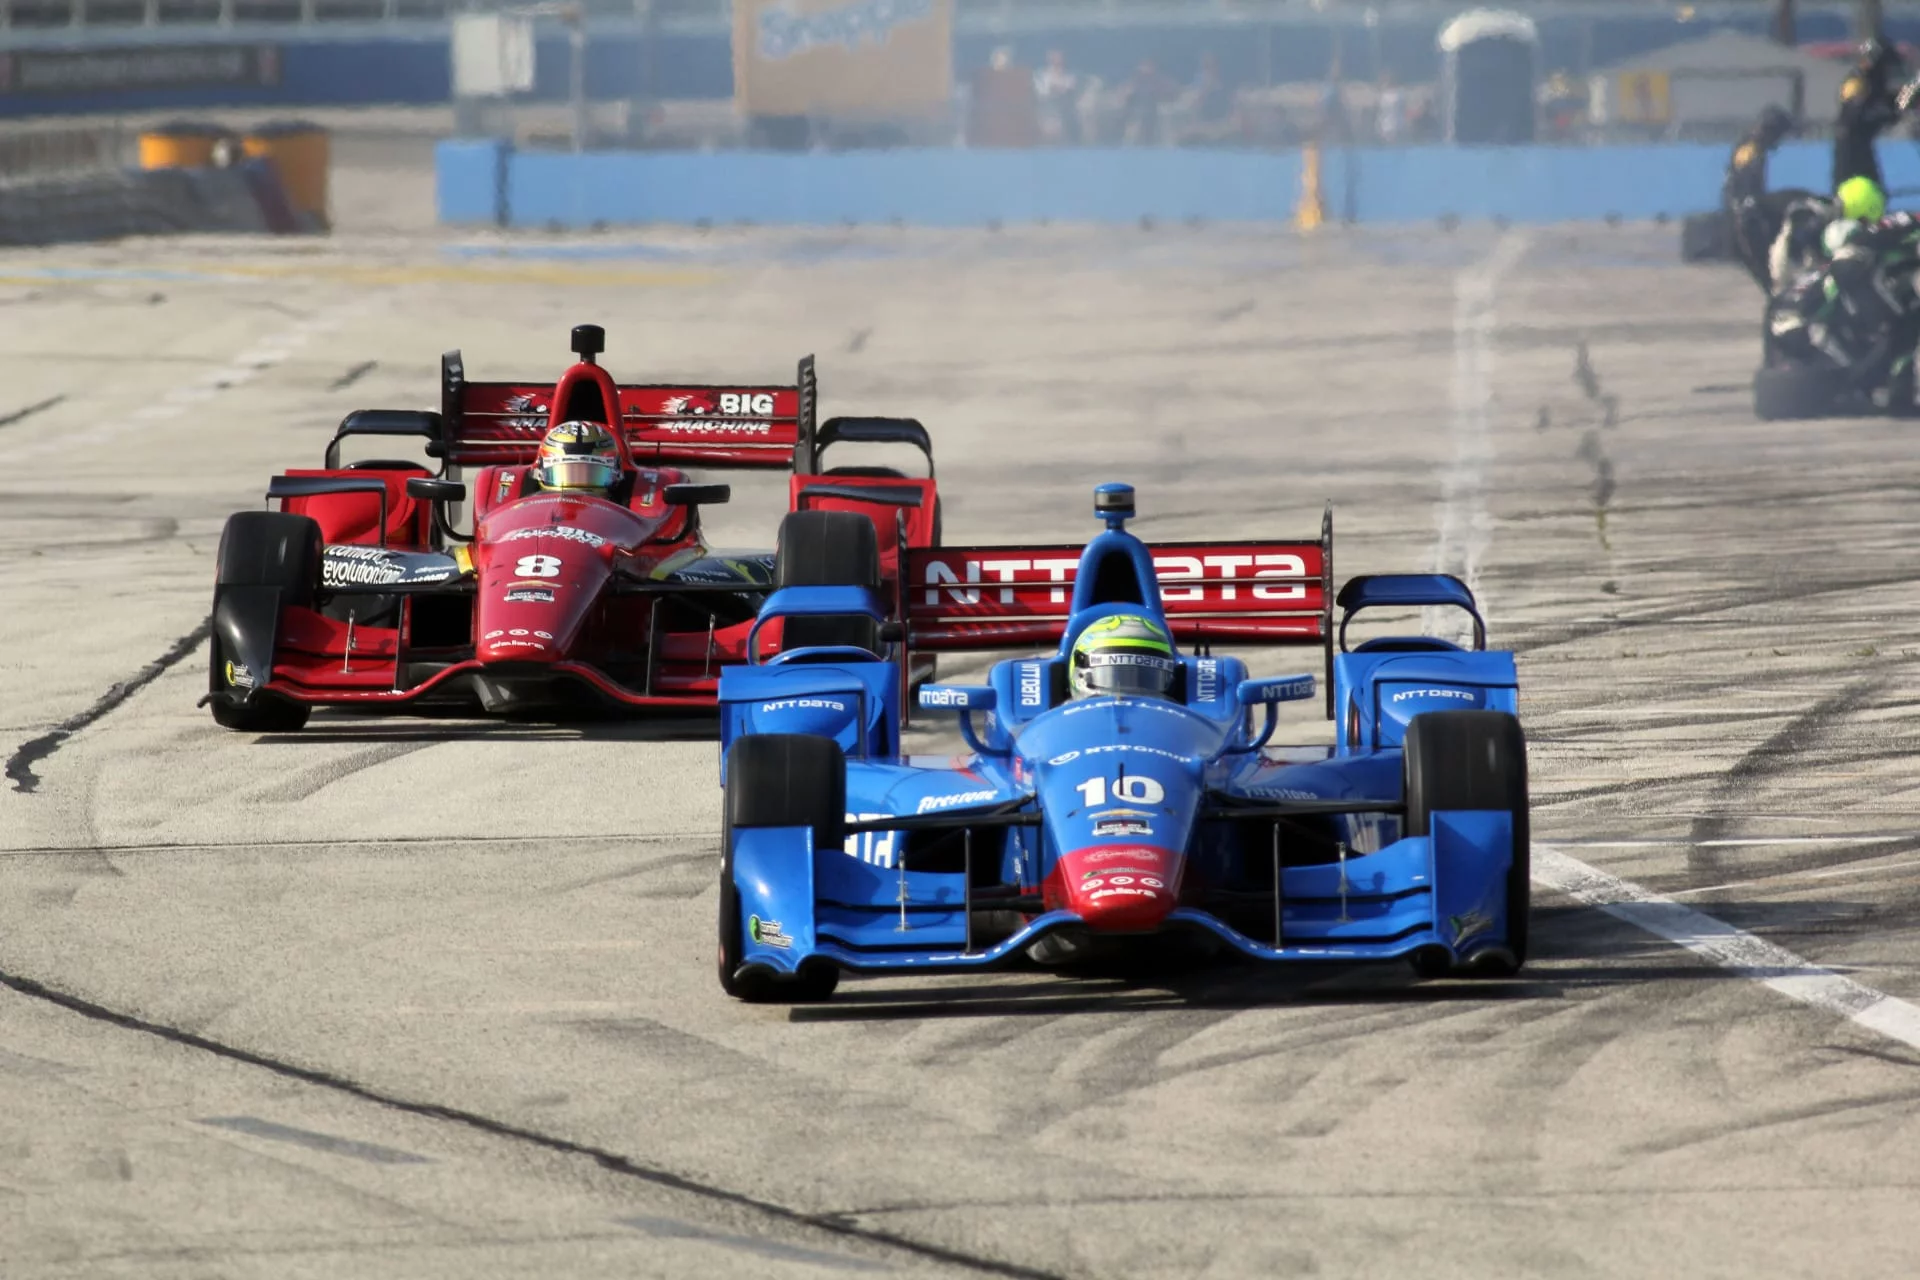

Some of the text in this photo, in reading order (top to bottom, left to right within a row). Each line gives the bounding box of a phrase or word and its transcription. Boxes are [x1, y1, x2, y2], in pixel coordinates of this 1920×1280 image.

[720, 394, 774, 415] BIG
[671, 421, 772, 432] MACHINE
[323, 559, 402, 584] evolution.com
[515, 555, 561, 577] 8
[926, 554, 1306, 605] NTT aTa
[1109, 655, 1133, 665] NTT
[1262, 683, 1290, 699] NTT
[1393, 689, 1427, 703] NTT
[763, 699, 797, 713] NTT
[1076, 775, 1165, 808] 10
